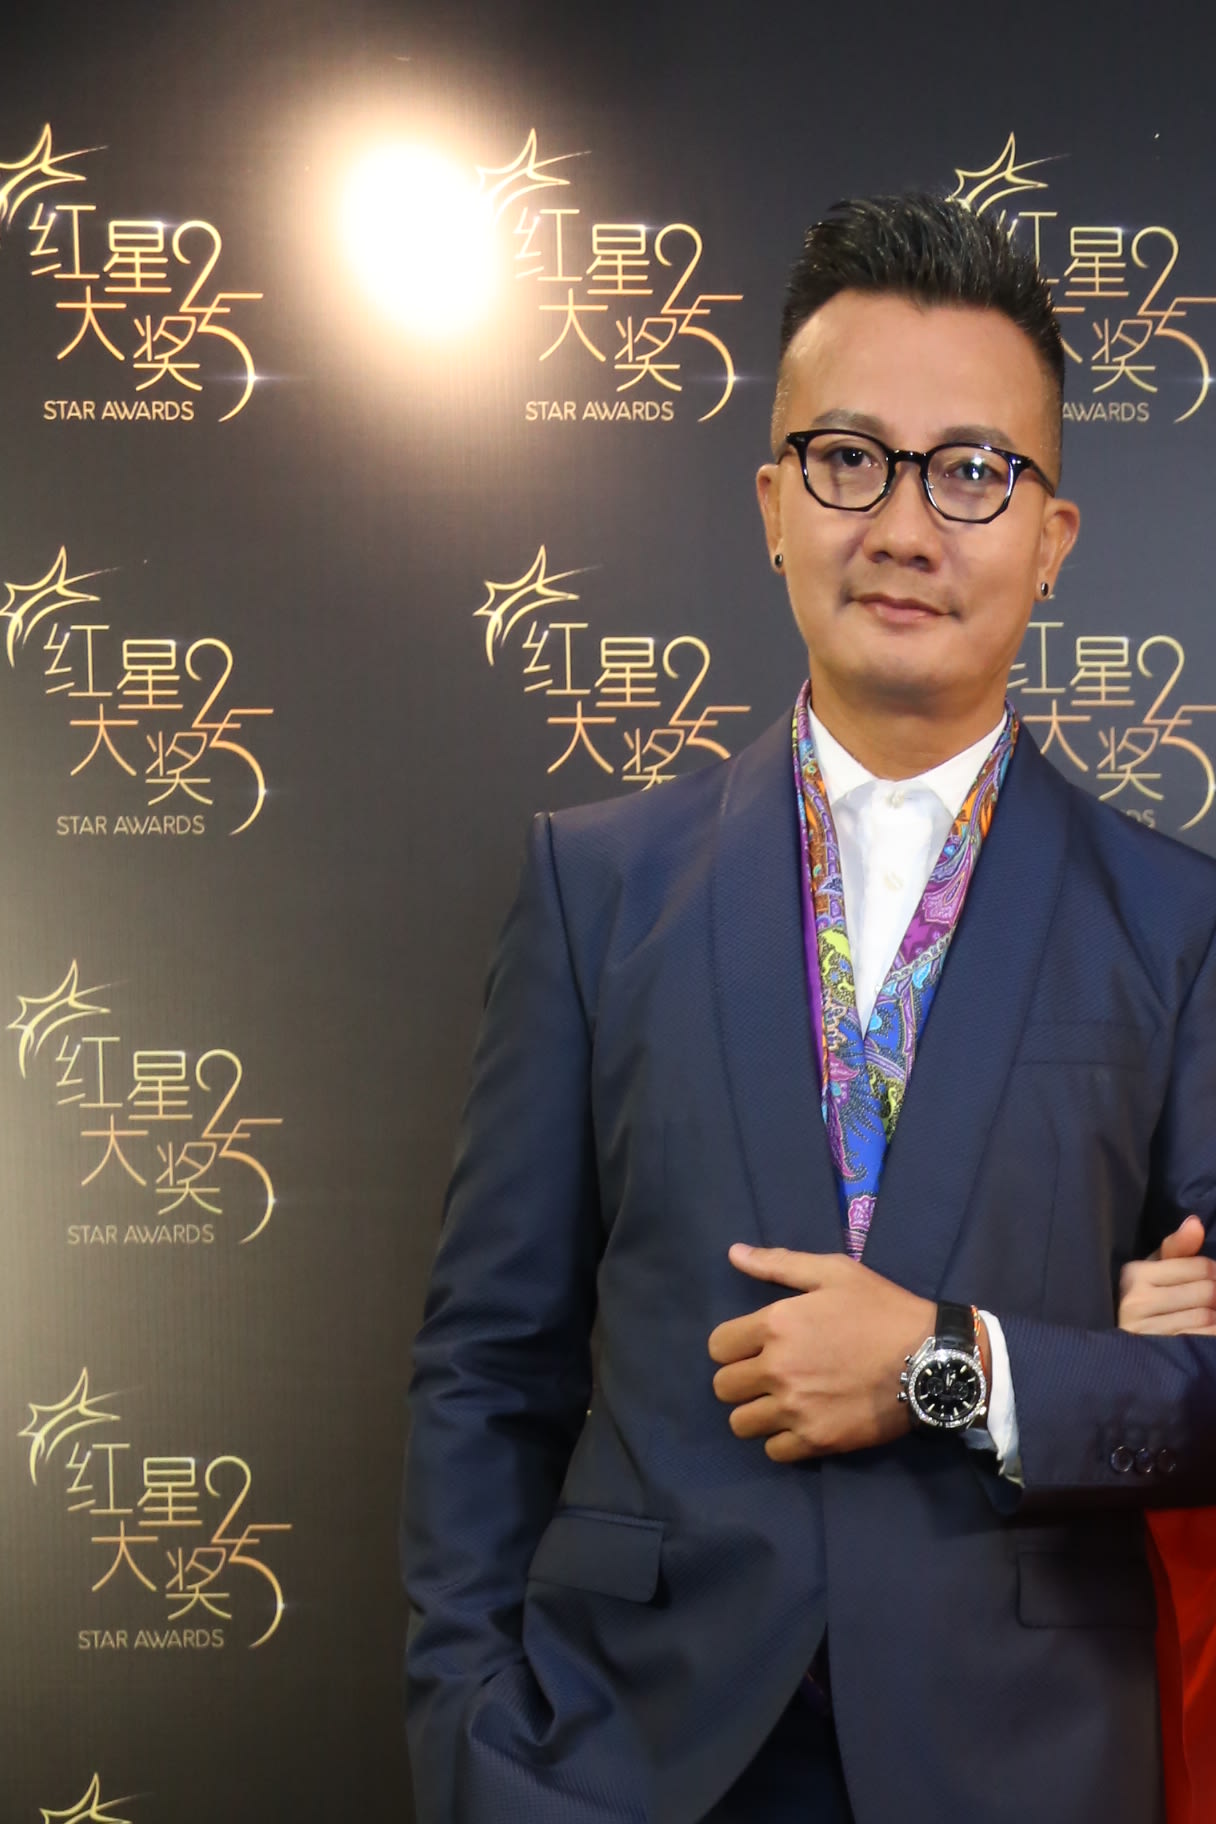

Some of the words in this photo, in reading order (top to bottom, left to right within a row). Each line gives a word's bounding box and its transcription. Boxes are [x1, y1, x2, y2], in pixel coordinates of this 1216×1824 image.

[28, 203, 171, 293] 红星
[512, 207, 654, 295] 红星
[56, 286, 204, 391] 大奖
[539, 288, 683, 392] 大奖
[43, 401, 96, 421] STAR
[101, 401, 195, 421] AWARDS
[525, 401, 577, 421] STAR
[581, 401, 675, 421] AWARDS
[1063, 402, 1149, 422] AWARDS
[43, 623, 184, 709] 红星
[522, 620, 661, 707] 红星
[69, 703, 213, 806] 大奖
[547, 700, 685, 791] 大奖
[1022, 699, 1164, 801] 大奖
[57, 816, 108, 836] STAR
[113, 815, 205, 836] AWARDS
[55, 1034, 193, 1120] 红星
[80, 1114, 223, 1215] 大奖
[67, 1224, 118, 1244] STAR
[124, 1223, 215, 1244] AWARDS
[65, 1442, 203, 1526] 红星
[91, 1520, 232, 1620] 大奖
[78, 1629, 128, 1649] STAR
[134, 1628, 225, 1649] AWARDS
